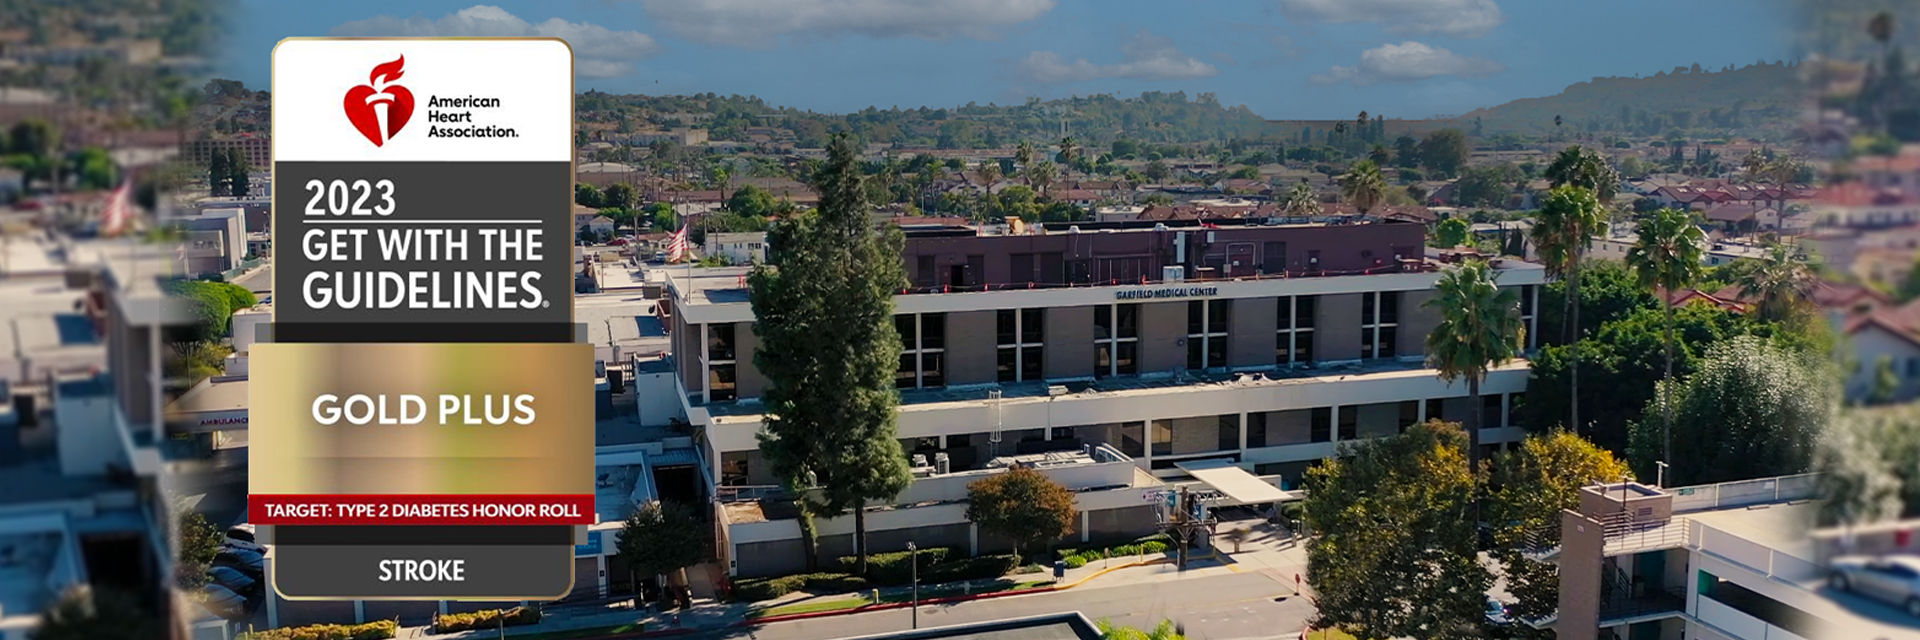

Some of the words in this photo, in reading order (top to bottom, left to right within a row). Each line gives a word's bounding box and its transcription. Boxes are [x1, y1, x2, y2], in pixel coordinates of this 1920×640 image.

[1116, 289, 1153, 300] GARFIELD
[1154, 287, 1188, 298] MEDICAL
[1189, 287, 1218, 297] CENTER
